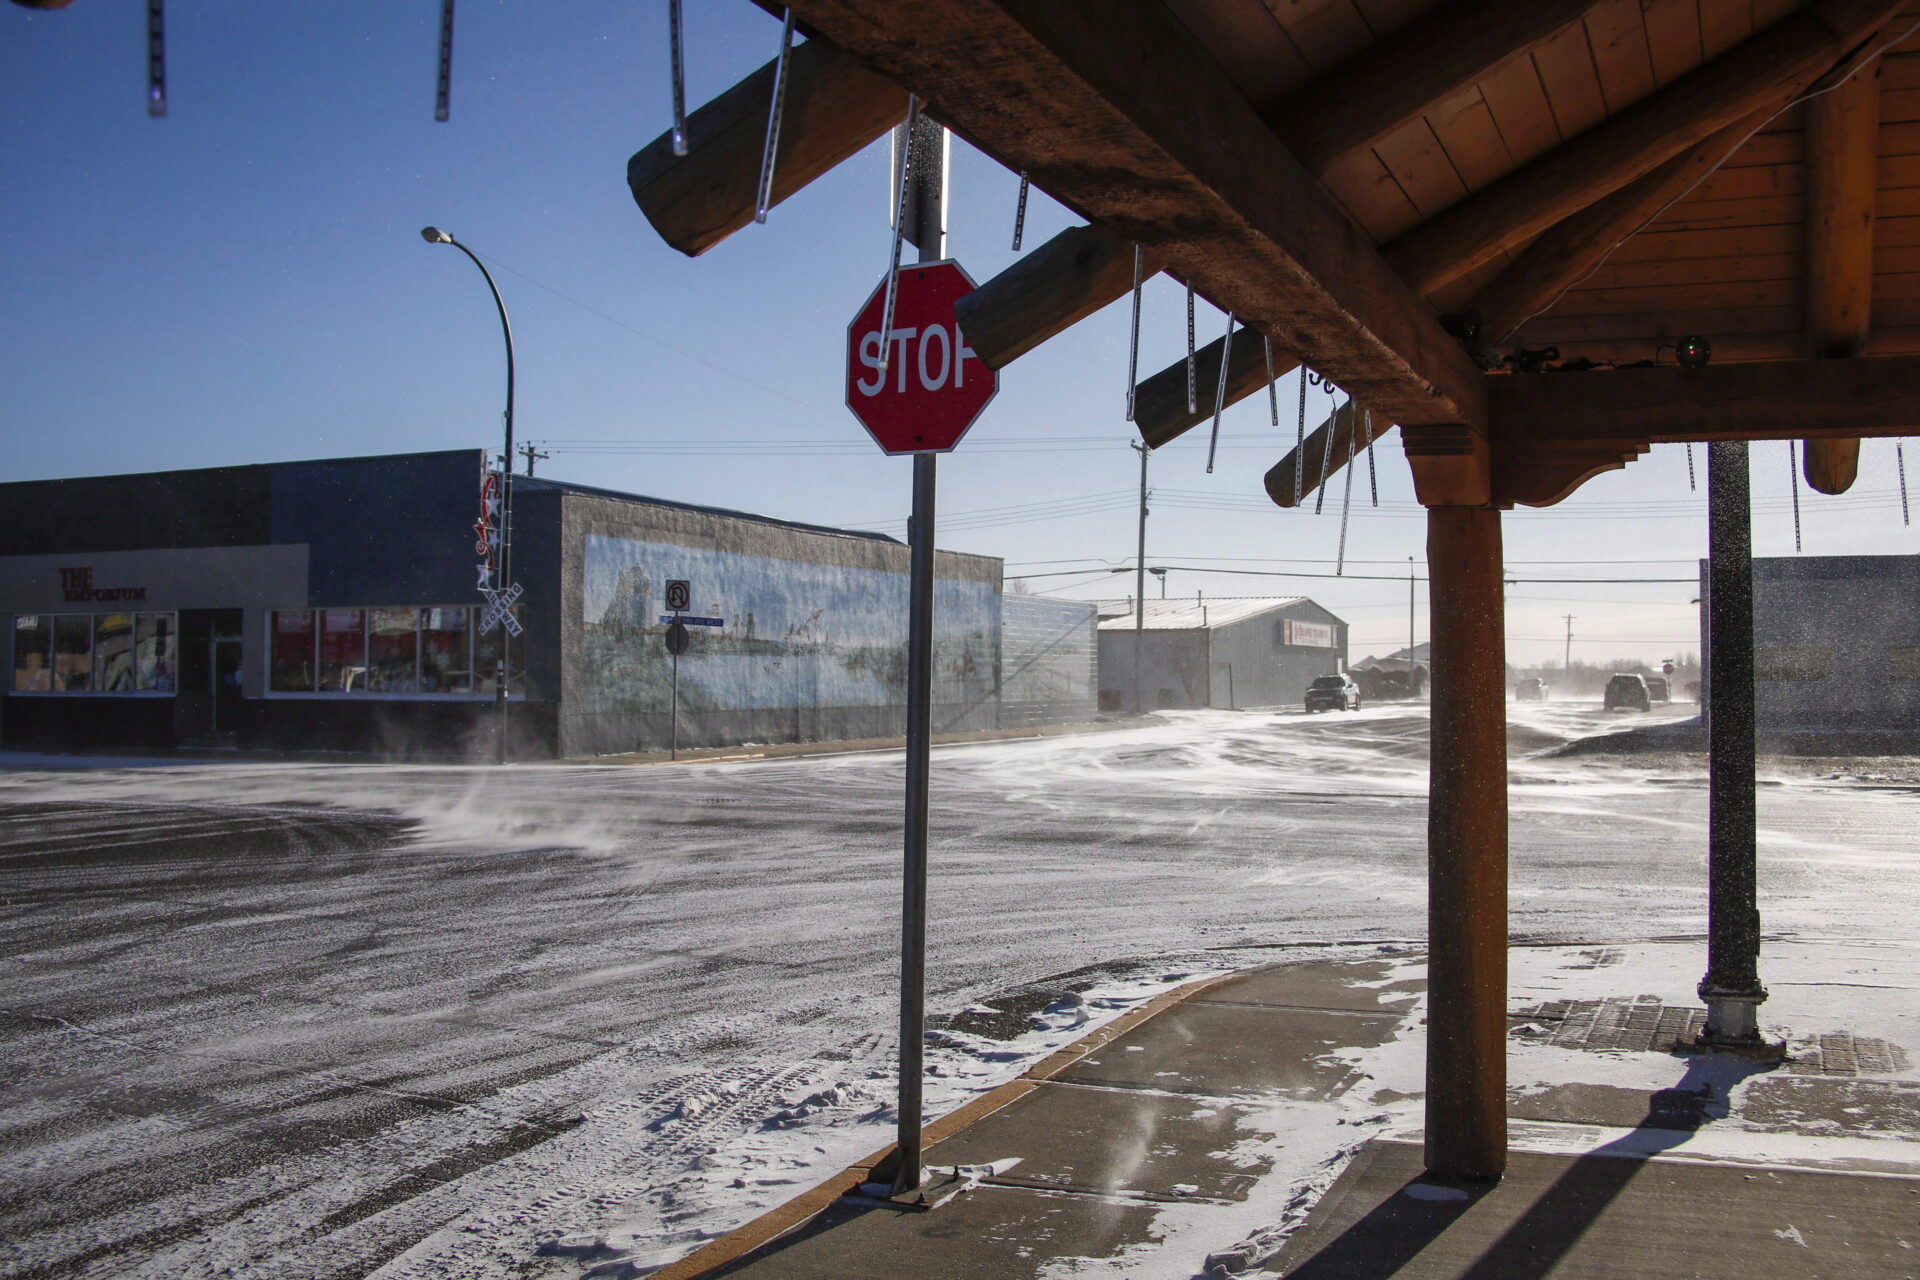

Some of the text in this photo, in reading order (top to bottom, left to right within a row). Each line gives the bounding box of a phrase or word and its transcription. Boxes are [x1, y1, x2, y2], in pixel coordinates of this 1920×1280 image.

[856, 322, 978, 397] STOP
[59, 567, 93, 589] THE
[64, 585, 147, 601] EMPORIUM
[479, 584, 522, 634] CROSSING
